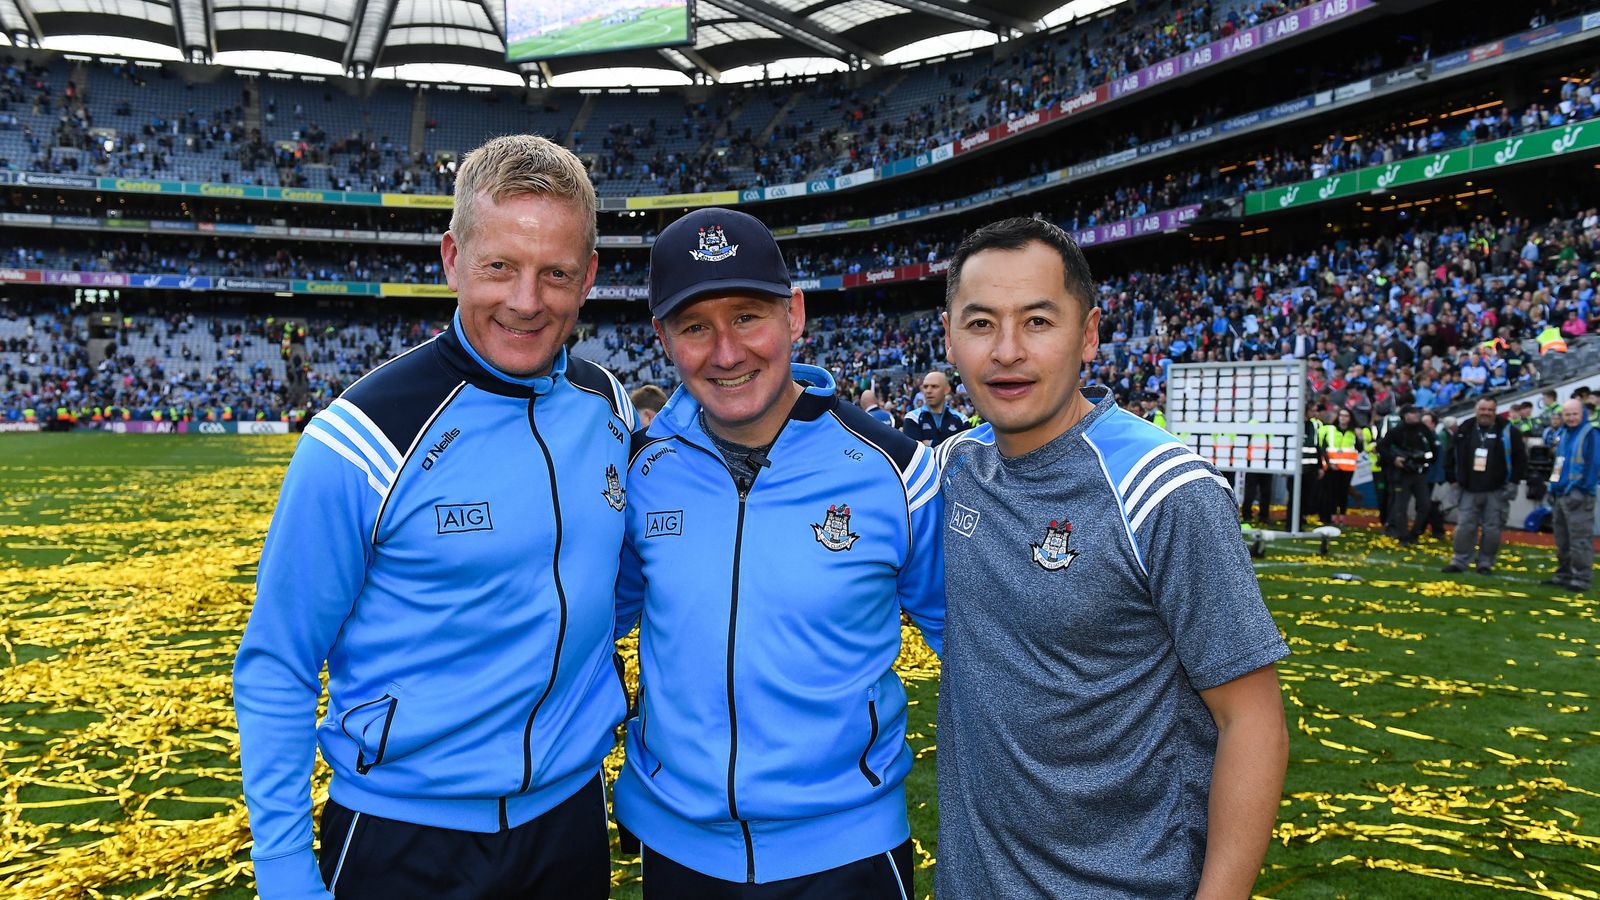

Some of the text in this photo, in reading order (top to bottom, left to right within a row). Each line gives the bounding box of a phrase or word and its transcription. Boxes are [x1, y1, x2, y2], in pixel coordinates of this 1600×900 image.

[1323, 0, 1349, 19] AIB
[1276, 15, 1300, 36] AIB
[1231, 33, 1253, 52] AIB
[1192, 48, 1212, 67] AIB
[1155, 62, 1174, 79] AIB
[1122, 75, 1139, 93] AIB
[1060, 91, 1097, 115] SuperValu
[1007, 112, 1040, 133] SuperValu
[960, 131, 990, 150] SuperValu
[1552, 126, 1584, 153] eir
[1494, 138, 1523, 165] eir
[1377, 164, 1401, 187] eir
[1424, 154, 1450, 179] eir
[115, 180, 161, 192] Centra
[200, 183, 244, 196] Centra
[281, 188, 324, 201] Centra
[1111, 223, 1127, 238] AIB
[1142, 215, 1160, 231] AIB
[1080, 229, 1095, 244] AIB
[60, 273, 80, 284] AIB
[103, 274, 124, 285] AIB
[306, 281, 348, 293] Centra
[791, 279, 820, 289] USEUM
[597, 287, 626, 298] CROKE
[421, 427, 461, 471] O'Neills
[843, 448, 865, 462] J.G.
[443, 508, 484, 528] AIG
[649, 515, 678, 533] AIG
[952, 510, 974, 530] AIG
